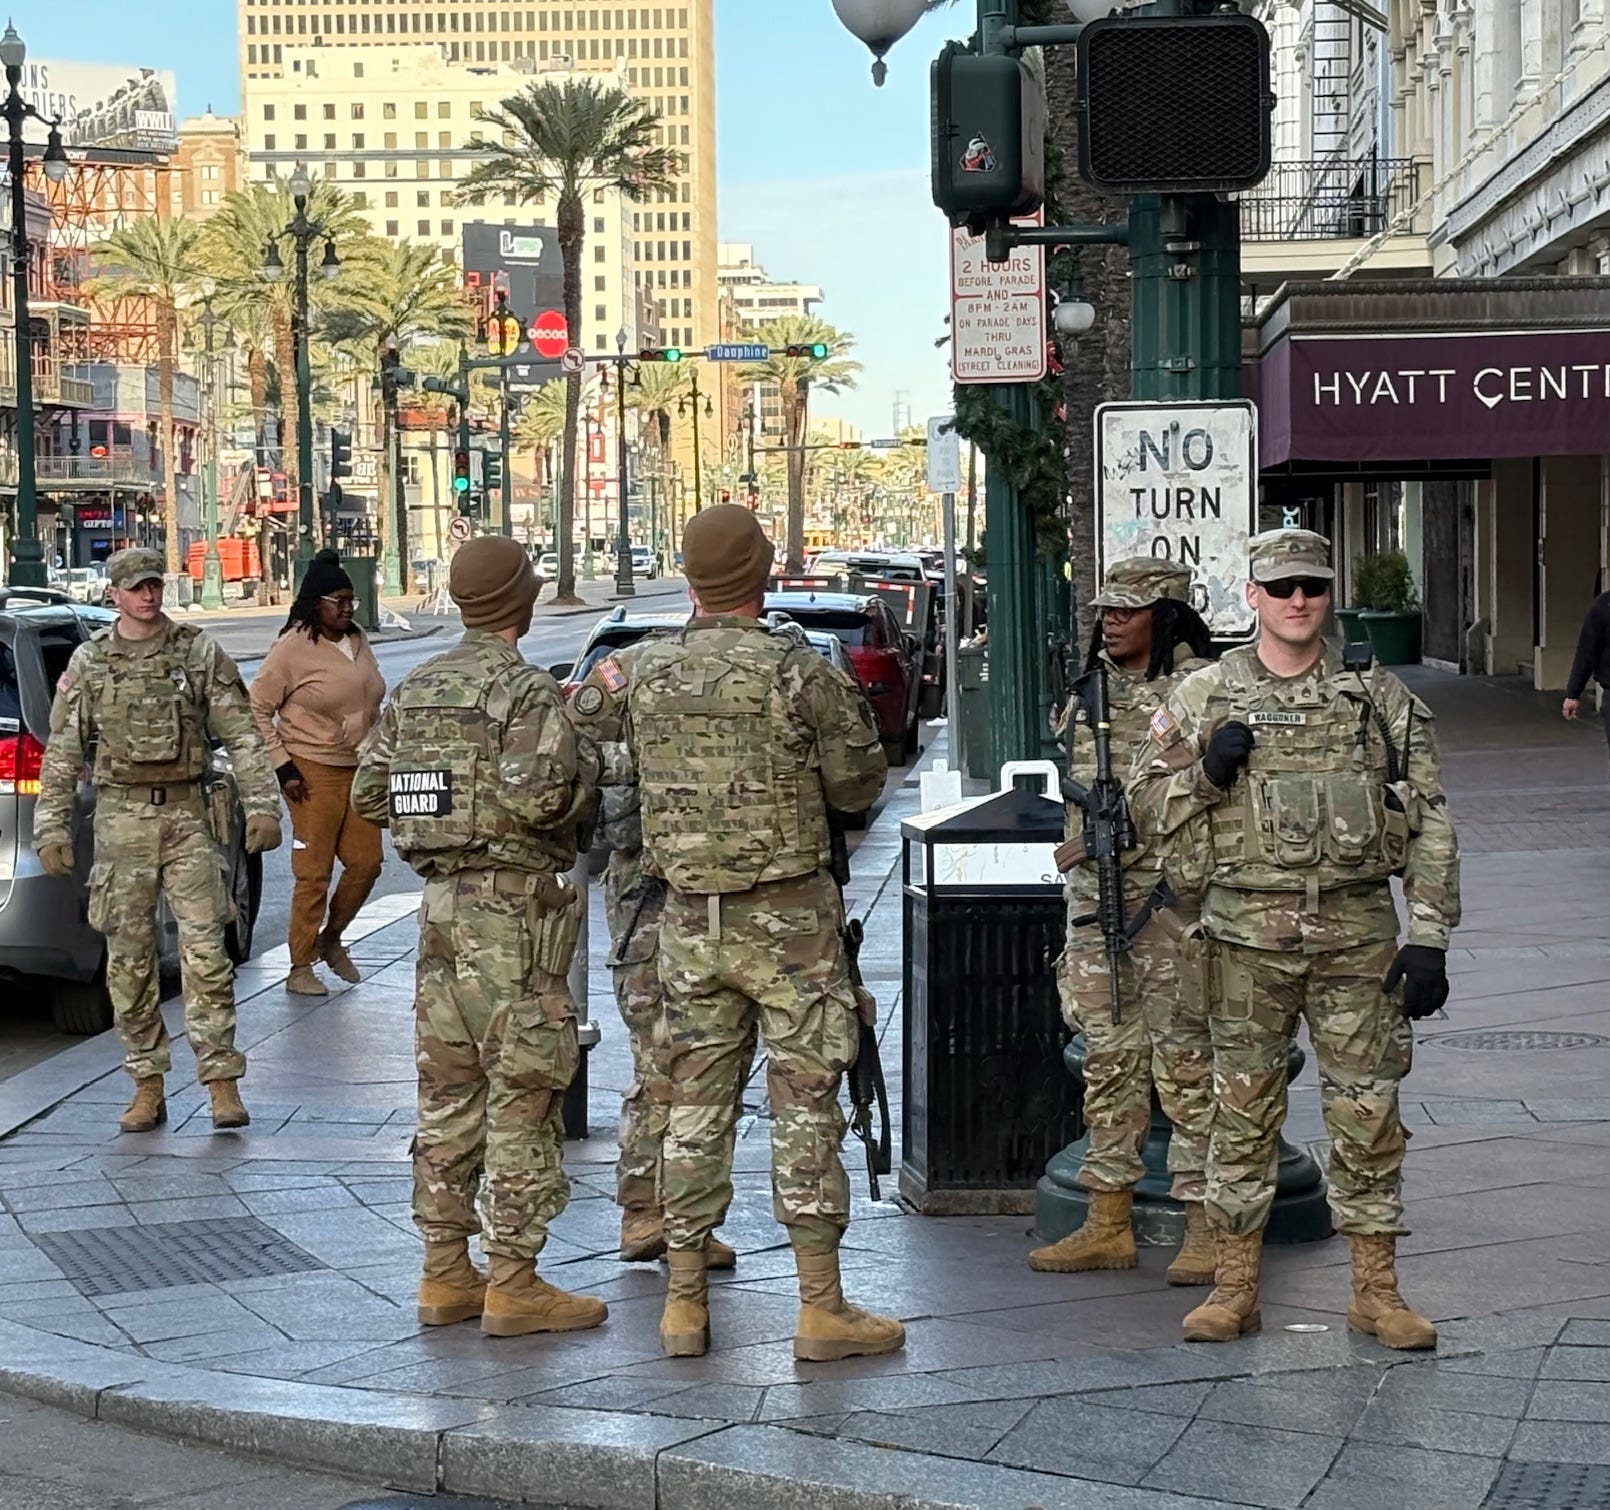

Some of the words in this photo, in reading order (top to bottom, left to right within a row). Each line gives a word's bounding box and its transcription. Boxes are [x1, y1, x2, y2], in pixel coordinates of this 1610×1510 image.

[962, 260, 971, 273] 2
[980, 258, 1031, 272] HOURS
[958, 277, 992, 287] BEFORE
[1000, 275, 1036, 286] PARADE
[987, 289, 1009, 301] AND
[1003, 302, 1028, 312] 2AM
[959, 319, 971, 329] ON
[977, 317, 1010, 328] PARADE
[1016, 317, 1037, 327] DAYS
[985, 332, 1012, 342] THRU
[717, 346, 767, 360] Dauphine
[1005, 346, 1032, 356] GRAS
[1314, 370, 1456, 406] HYATT
[1473, 364, 1610, 409] CENT
[1139, 428, 1213, 472] NO
[1130, 486, 1221, 520] TURN
[1151, 535, 1200, 567] ON
[395, 793, 438, 814] GUARD
